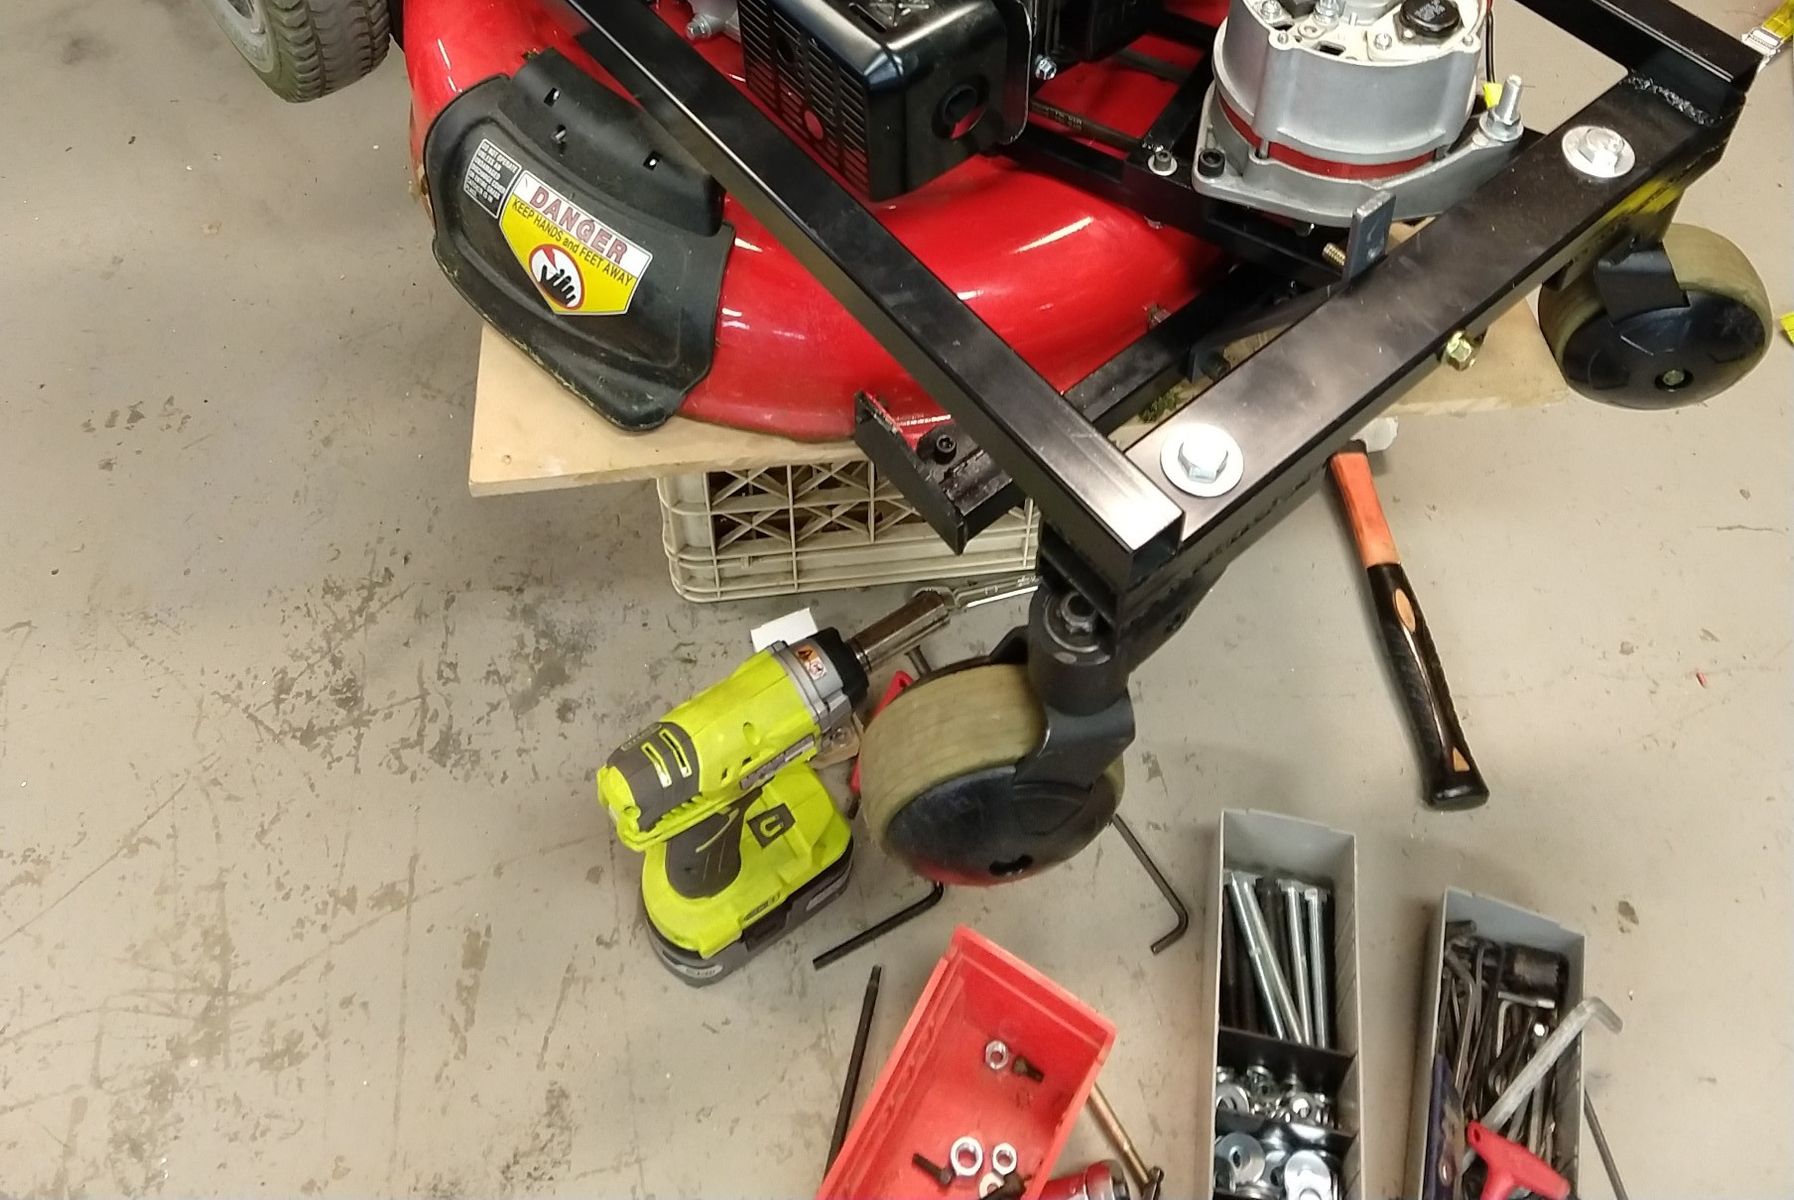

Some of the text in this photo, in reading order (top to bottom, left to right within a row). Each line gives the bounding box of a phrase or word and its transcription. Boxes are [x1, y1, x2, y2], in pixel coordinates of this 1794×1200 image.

[512, 199, 633, 287] KEEP HANDS and FEET AWAY
[529, 185, 628, 265] DANGER
